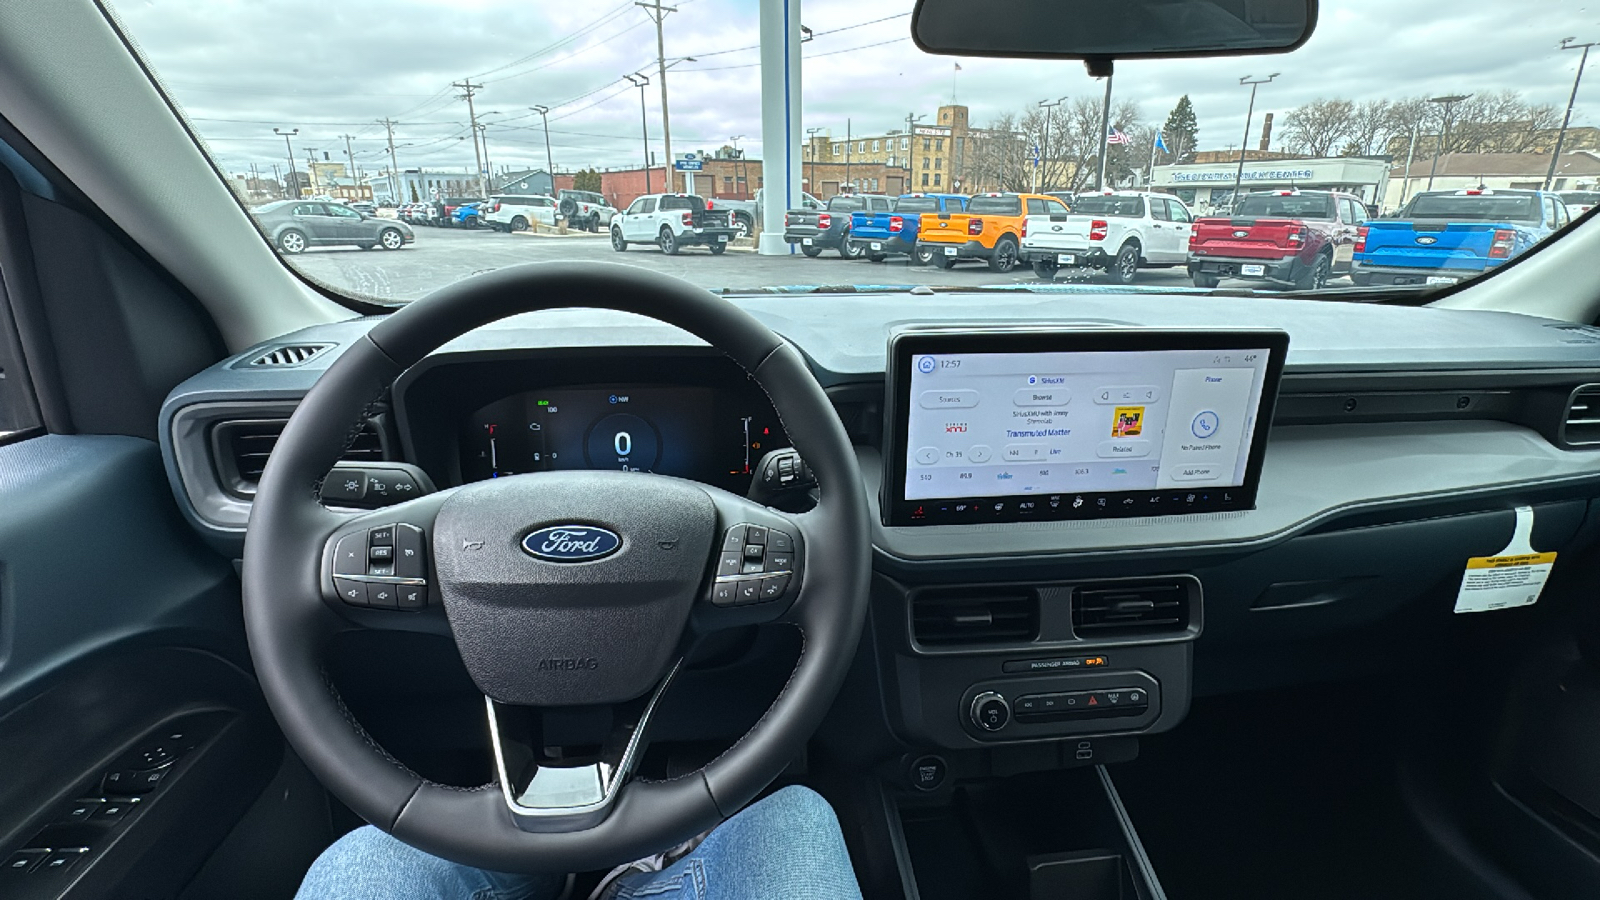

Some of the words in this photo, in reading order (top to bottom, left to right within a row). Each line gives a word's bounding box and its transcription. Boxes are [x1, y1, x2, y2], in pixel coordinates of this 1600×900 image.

[940, 360, 961, 368] 12:57
[1006, 428, 1047, 438] Transmuted
[1048, 428, 1071, 436] Matter
[614, 431, 631, 456] 0
[622, 464, 629, 472] 0
[1019, 502, 1035, 510] AUTO
[541, 529, 601, 553] Ford
[537, 657, 599, 672] AIRBAG
